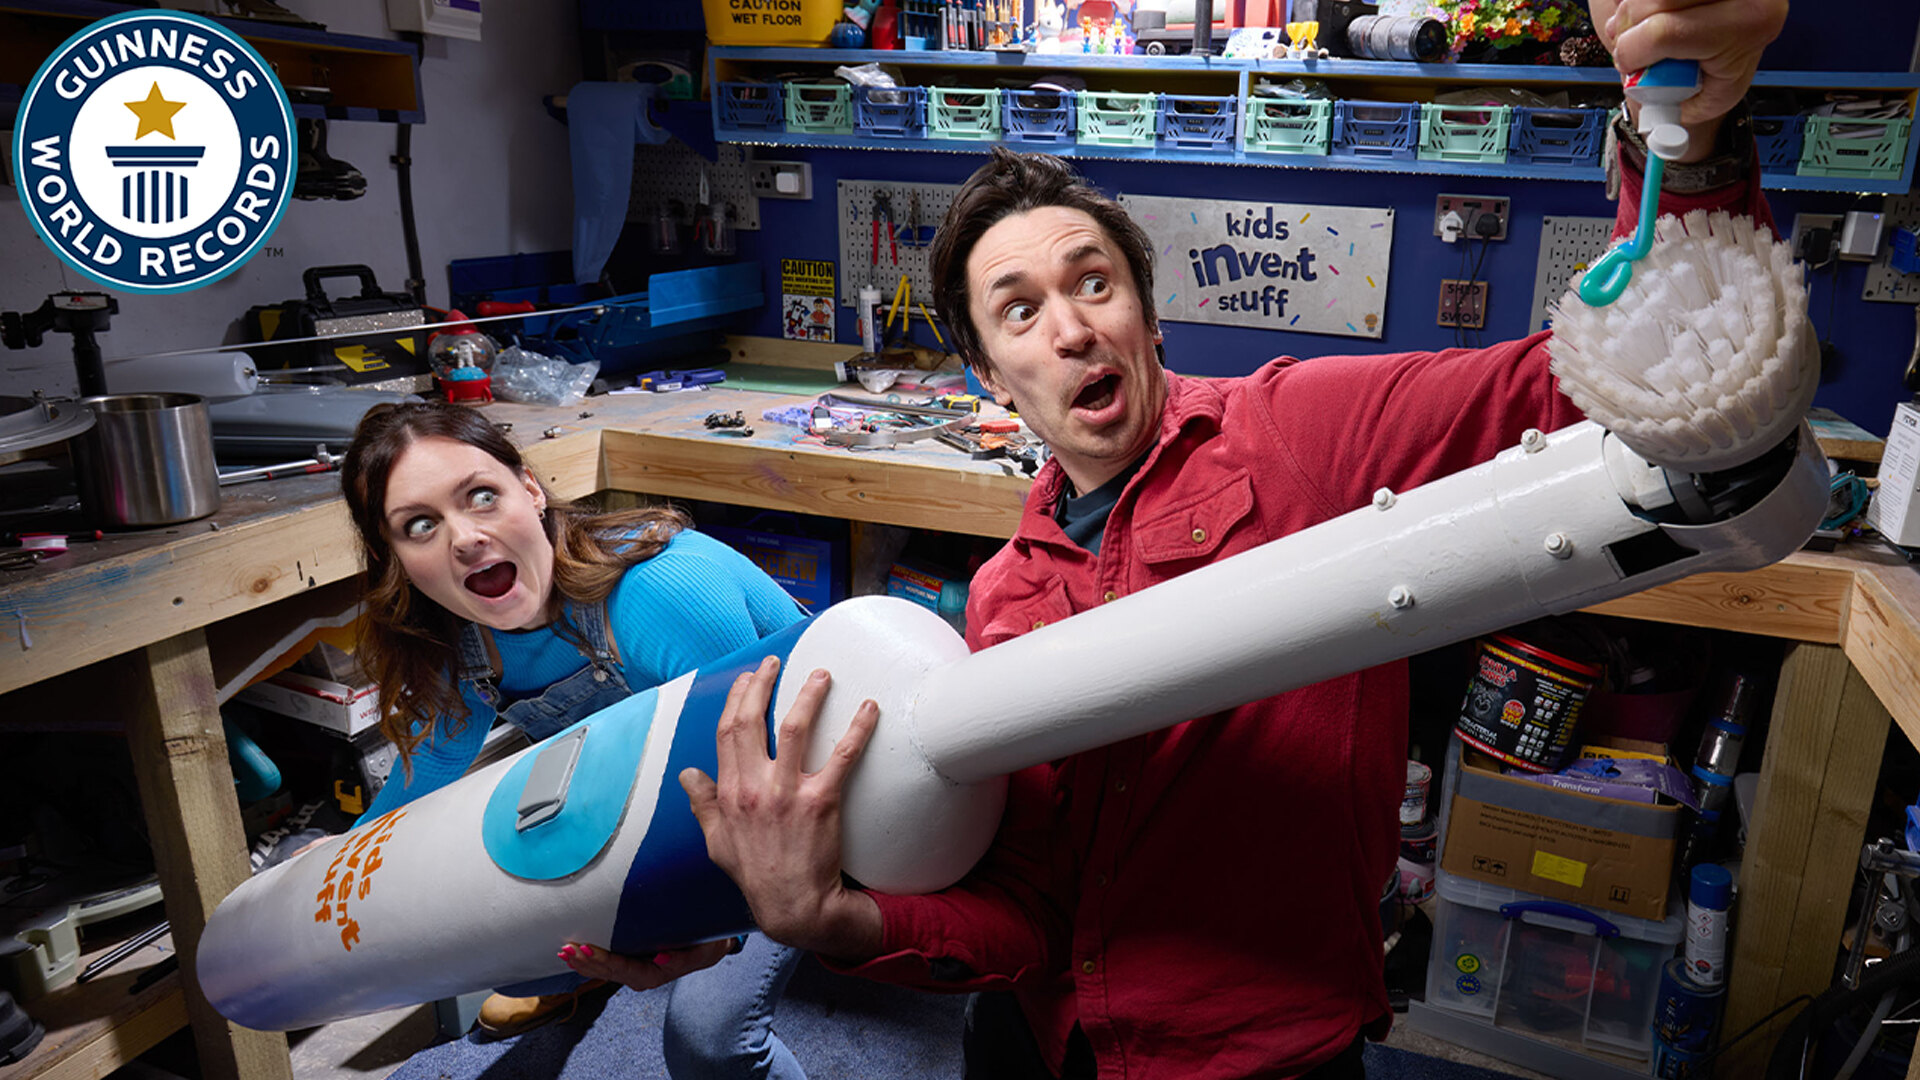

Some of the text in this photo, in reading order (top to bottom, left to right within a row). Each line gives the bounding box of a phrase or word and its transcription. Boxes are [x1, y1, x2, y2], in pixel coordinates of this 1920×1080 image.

[729, 0, 802, 11] CAUTION
[731, 13, 802, 26] WET FLOOR
[1225, 207, 1290, 241] kids
[782, 261, 833, 277] CAUTION
[1188, 244, 1318, 288] invent
[1448, 284, 1480, 295] SHED
[1218, 285, 1289, 318] stuff
[1551, 778, 1601, 795] Transform
